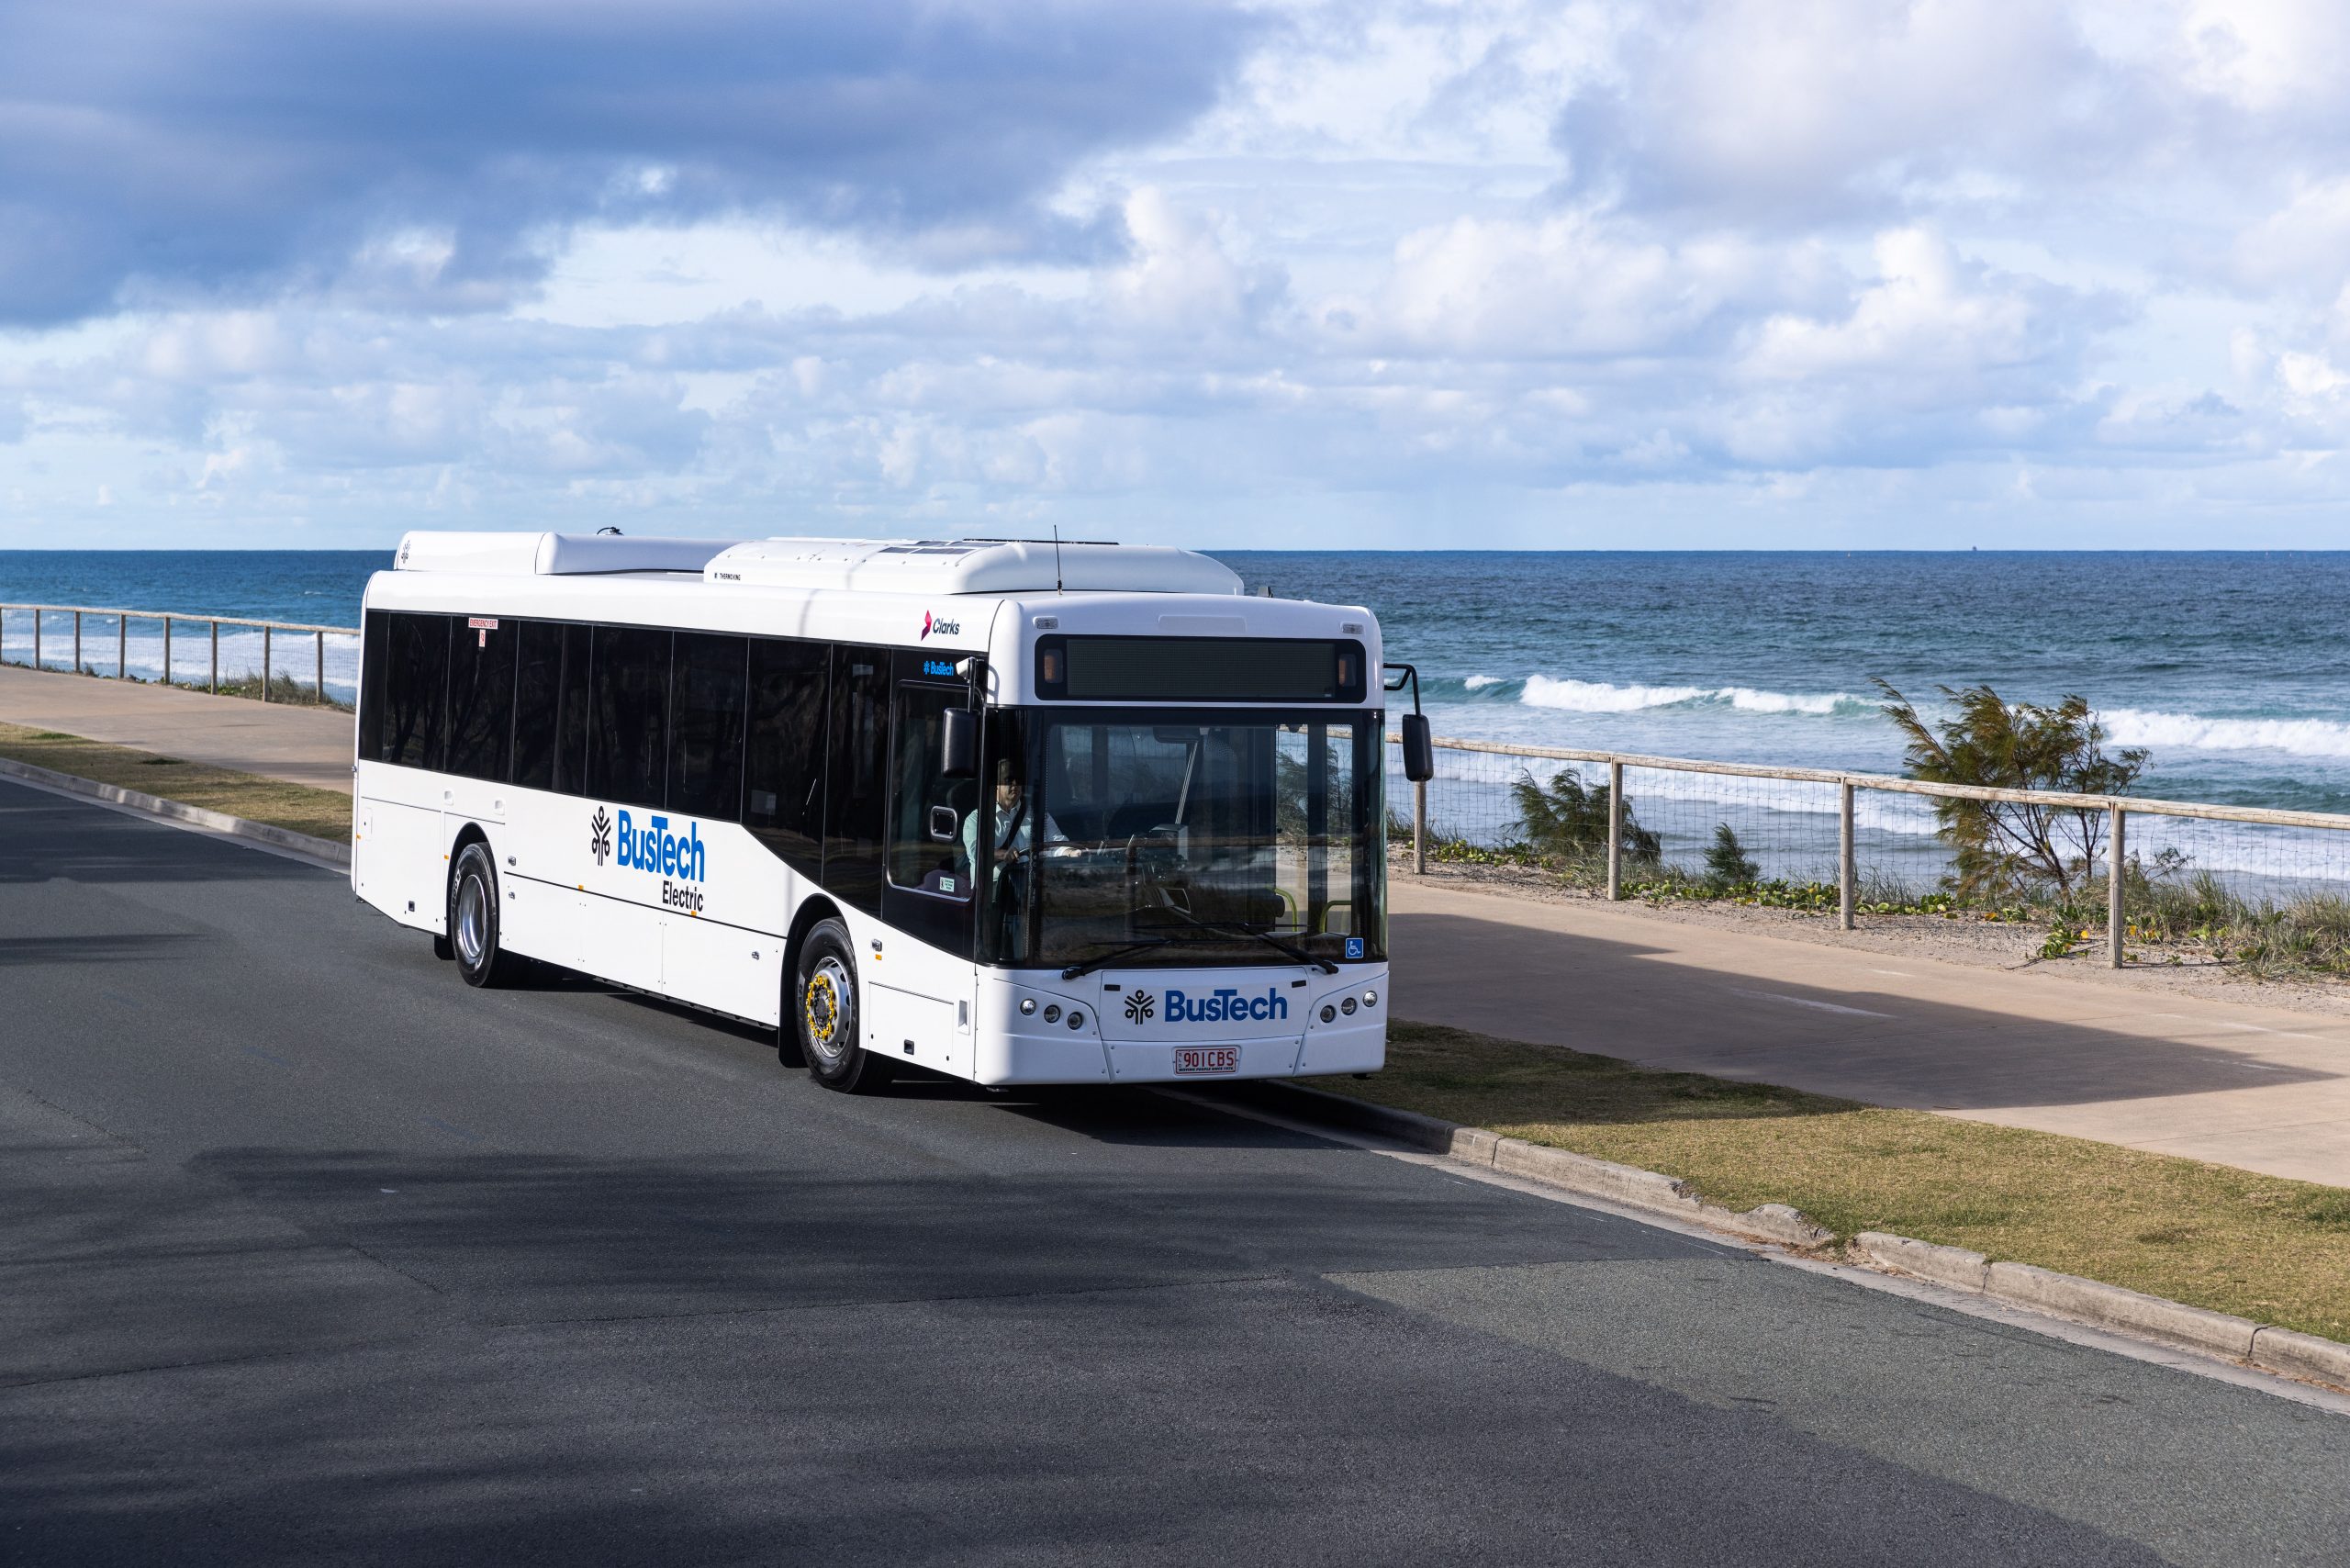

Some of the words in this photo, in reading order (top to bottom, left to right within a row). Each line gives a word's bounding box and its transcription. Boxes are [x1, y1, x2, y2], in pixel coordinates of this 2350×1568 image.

[470, 619, 489, 627] EMERGENCY
[489, 620, 498, 628] EXIT
[933, 618, 960, 635] Clarks
[931, 661, 954, 676] BusTech
[617, 809, 705, 882] BusTech
[662, 880, 703, 912] Electric
[1165, 988, 1288, 1023] BusTech
[1184, 1051, 1234, 1067] 901CBS
